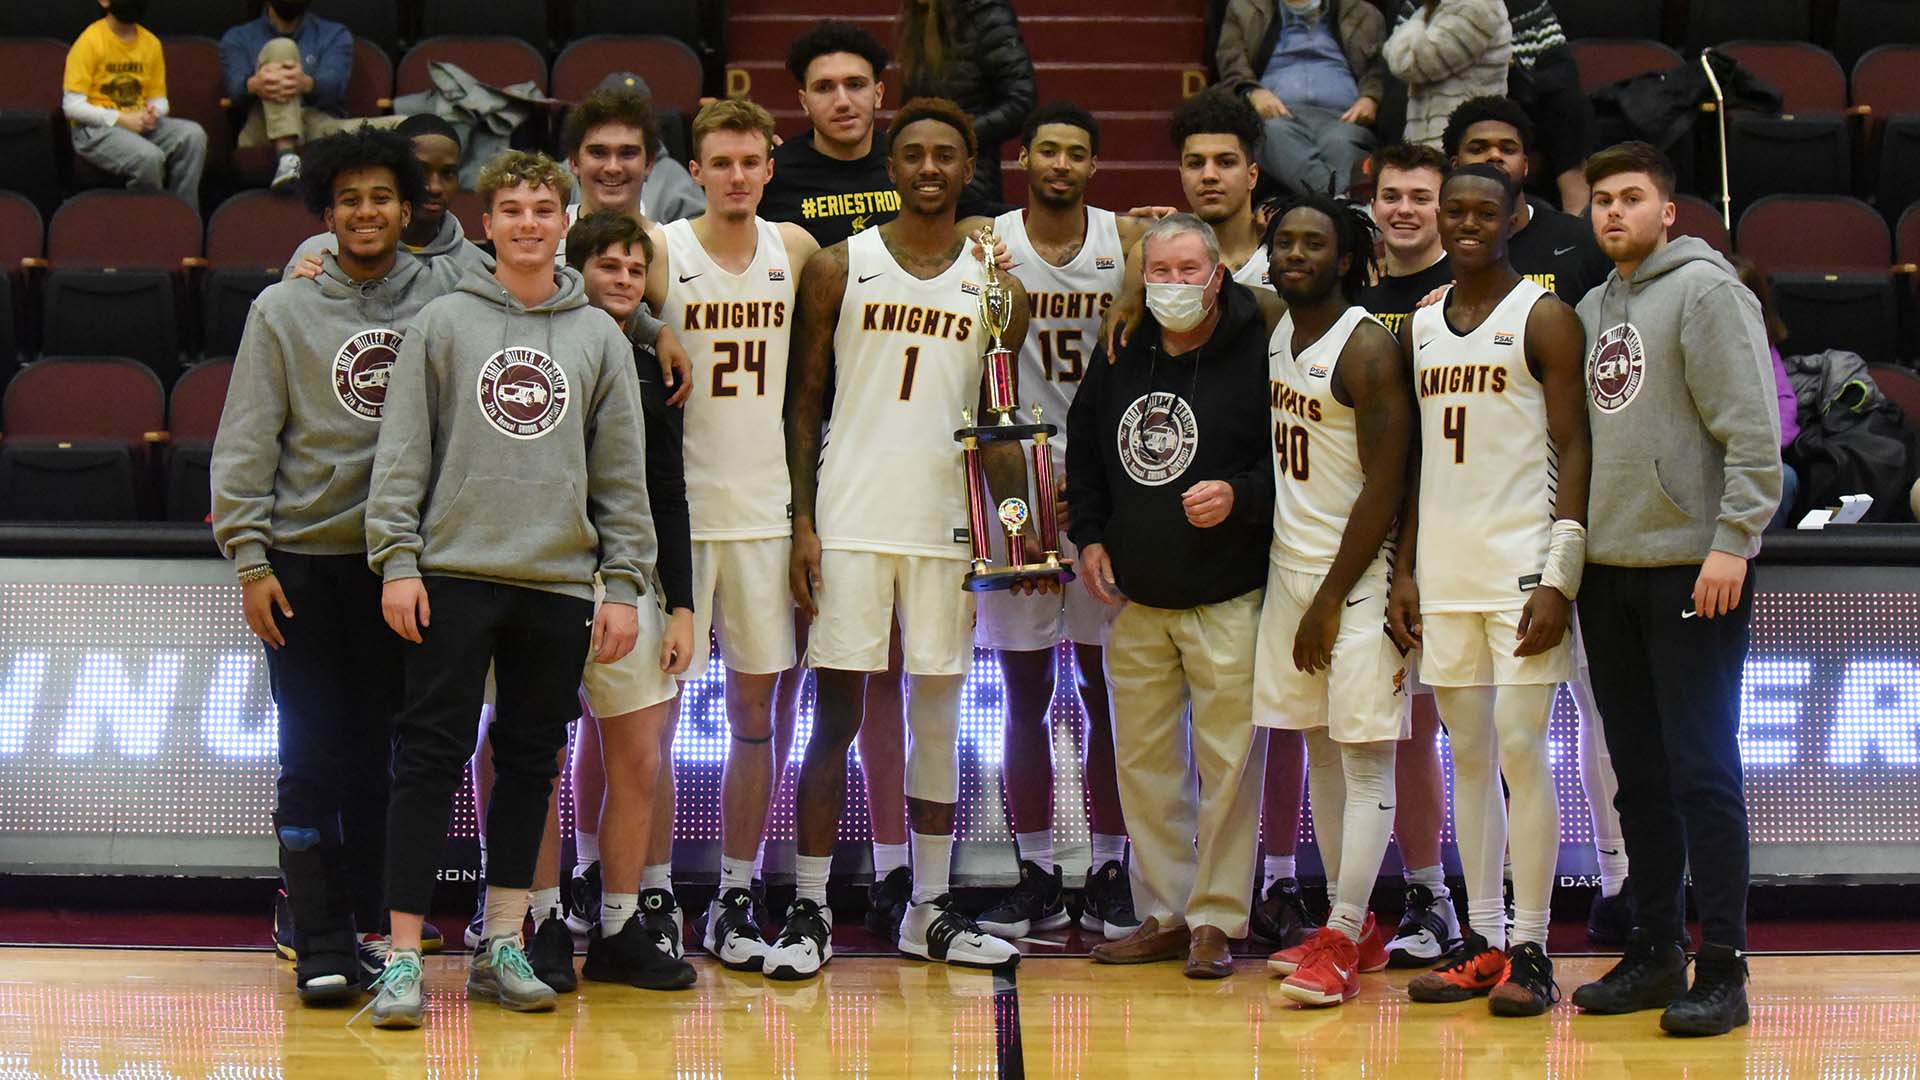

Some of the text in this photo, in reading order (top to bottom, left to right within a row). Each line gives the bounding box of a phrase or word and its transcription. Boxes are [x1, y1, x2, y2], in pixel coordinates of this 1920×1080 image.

[801, 190, 902, 219] #ERIESTRON
[684, 301, 785, 331] KNIGHTS
[862, 302, 973, 342] KNIGHTS
[1026, 290, 1114, 319] NIGHTS
[354, 332, 386, 352] MILLER
[1037, 328, 1083, 384] 15
[1494, 335, 1515, 343] PSAC
[505, 351, 536, 365] MILLER
[711, 339, 767, 398] 24
[898, 345, 921, 402] 1
[1420, 364, 1508, 399] KNIGHTS
[1275, 419, 1310, 483] 40
[1443, 404, 1467, 465] 4
